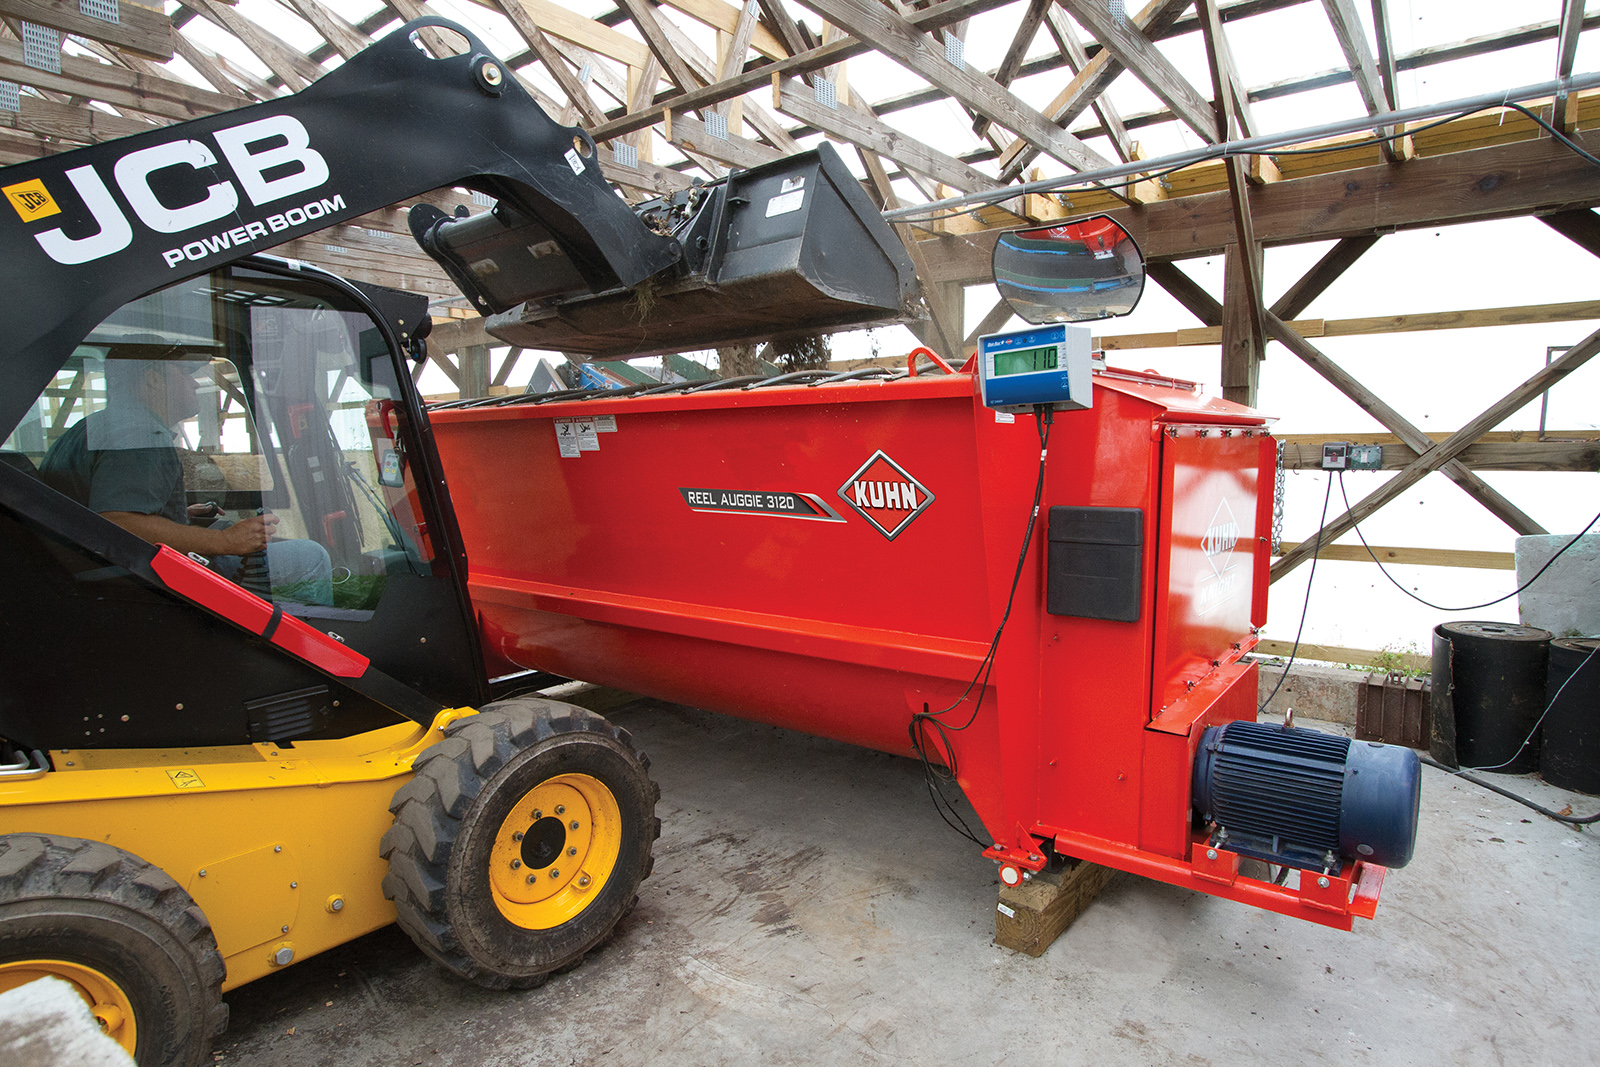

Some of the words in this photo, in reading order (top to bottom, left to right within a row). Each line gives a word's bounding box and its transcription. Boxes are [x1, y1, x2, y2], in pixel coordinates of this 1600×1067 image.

[17, 191, 47, 210] JCB
[33, 114, 330, 265] JCB
[162, 221, 269, 269] POWER
[266, 194, 347, 231] BOOM
[688, 491, 717, 505] REEL
[720, 493, 764, 508] AUGGIE
[766, 495, 795, 509] 3120
[853, 480, 918, 511] KUHN
[1207, 521, 1237, 557] KUHN
[1200, 572, 1236, 606] KNIGHT
